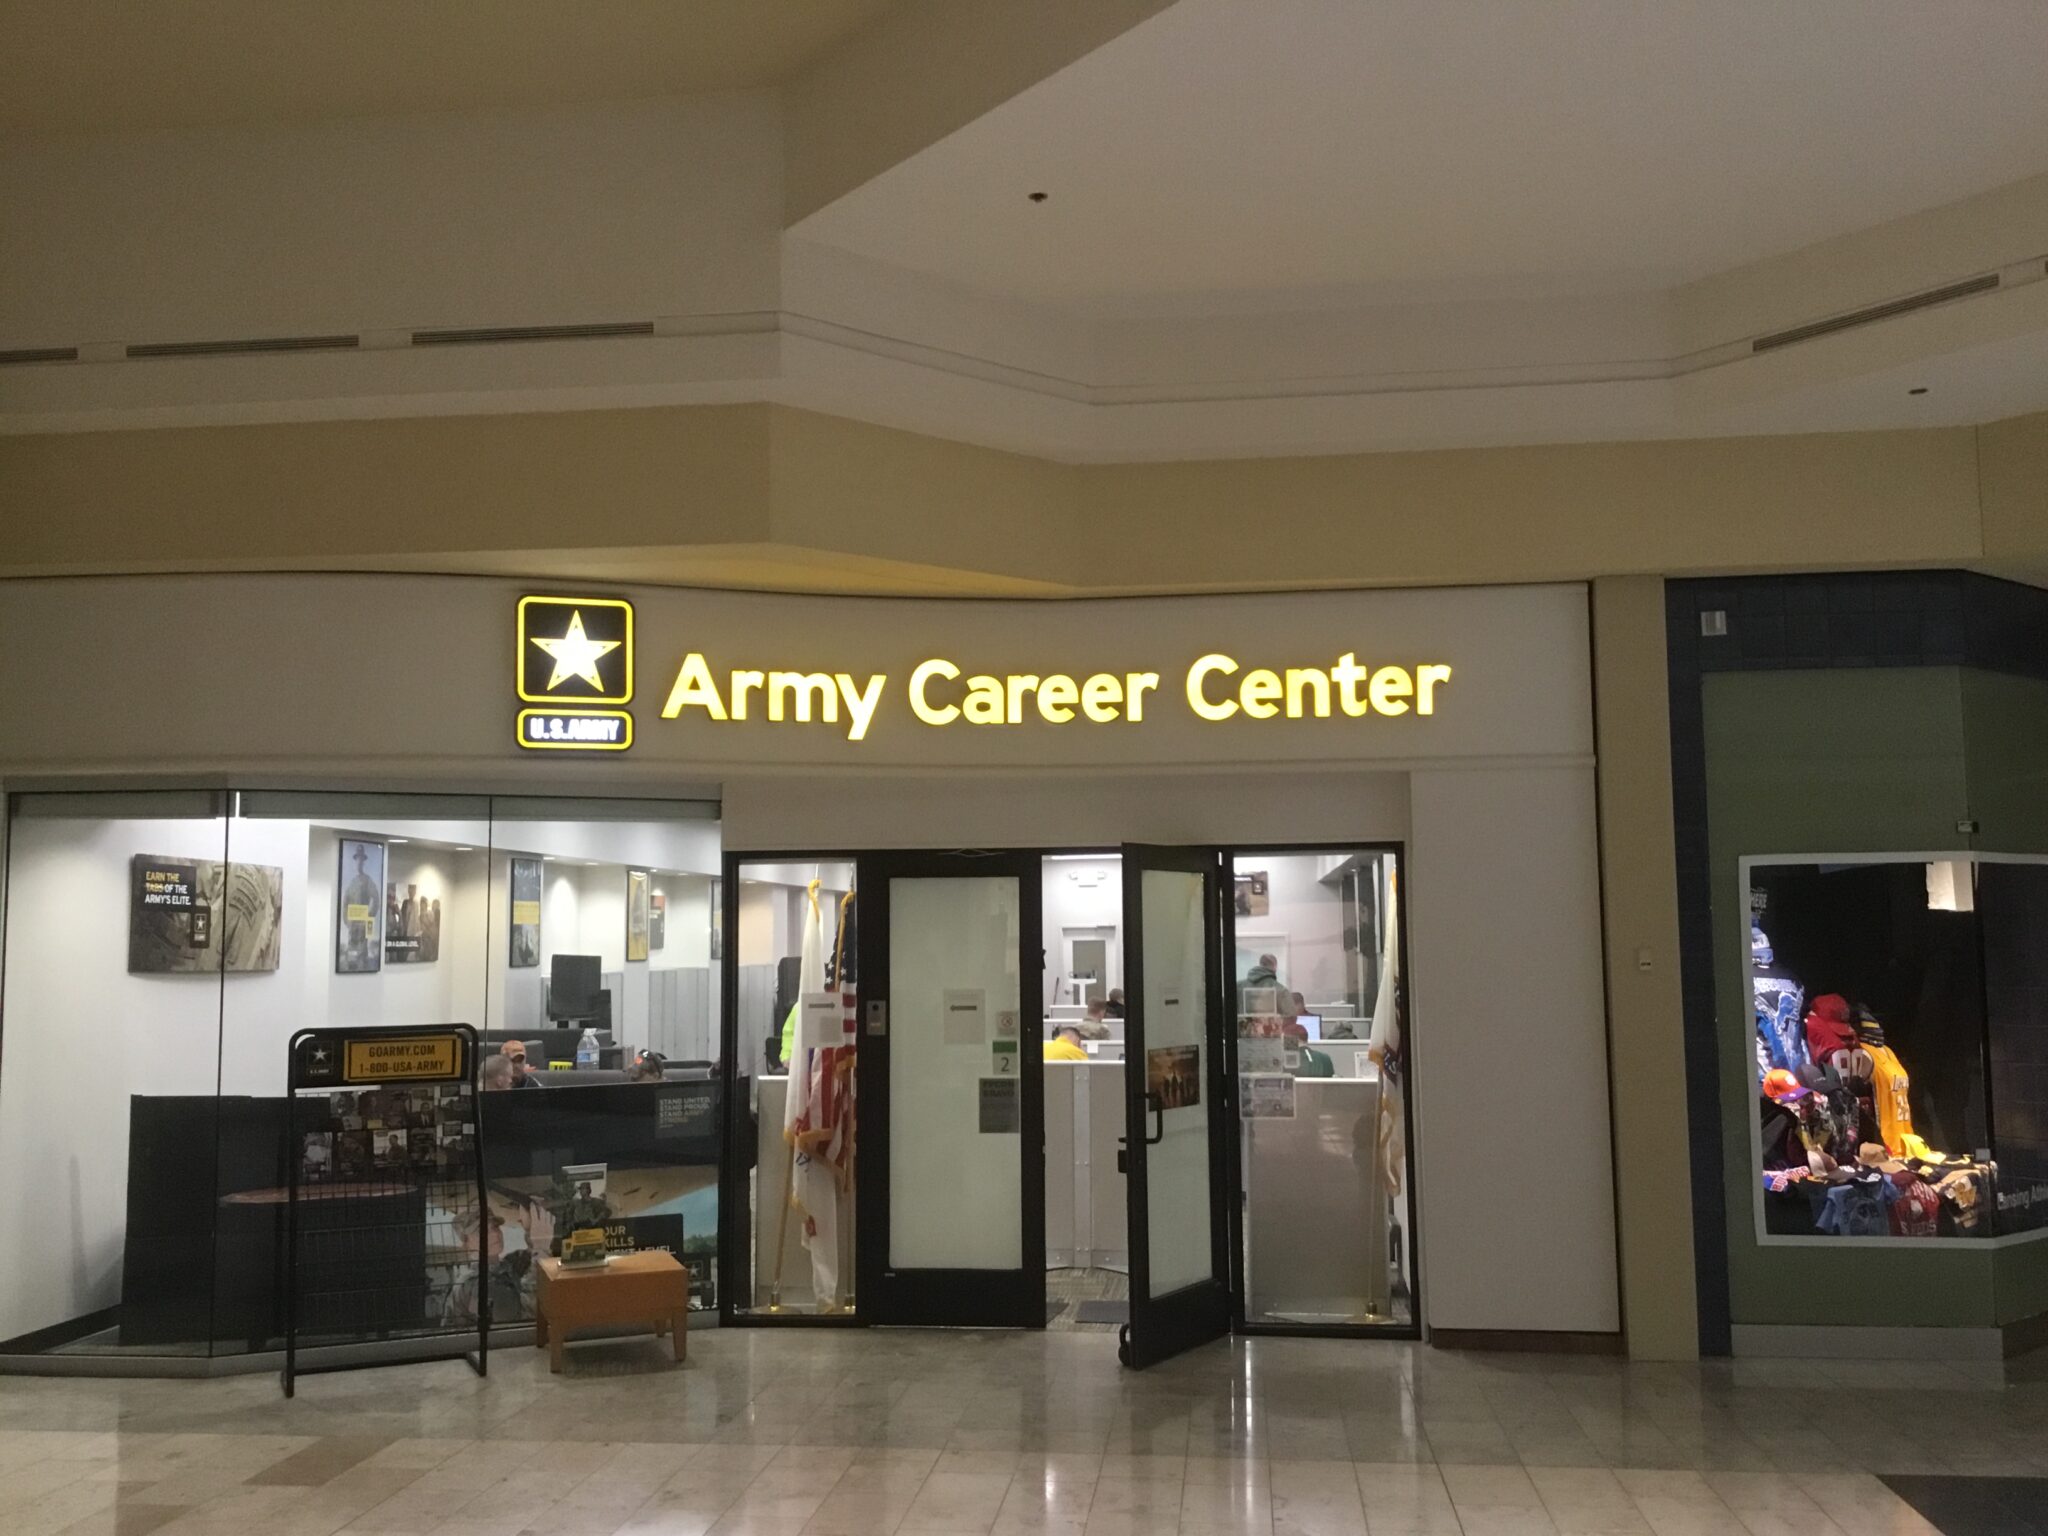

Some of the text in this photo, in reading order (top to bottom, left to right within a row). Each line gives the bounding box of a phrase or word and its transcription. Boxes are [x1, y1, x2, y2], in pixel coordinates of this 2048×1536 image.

[660, 652, 1452, 741] Army Career Center
[567, 718, 620, 741] ARMY
[146, 871, 180, 883] EARN THE
[164, 883, 174, 893] OF
[175, 884, 188, 894] THE
[144, 894, 171, 904] ARMY'S
[369, 1045, 436, 1058] GOARMY.COM
[359, 1060, 446, 1074] 1-800-USA-ARMY
[1000, 1057, 1010, 1072] 2
[604, 1225, 626, 1236] OUR
[604, 1236, 635, 1248] KILLS
